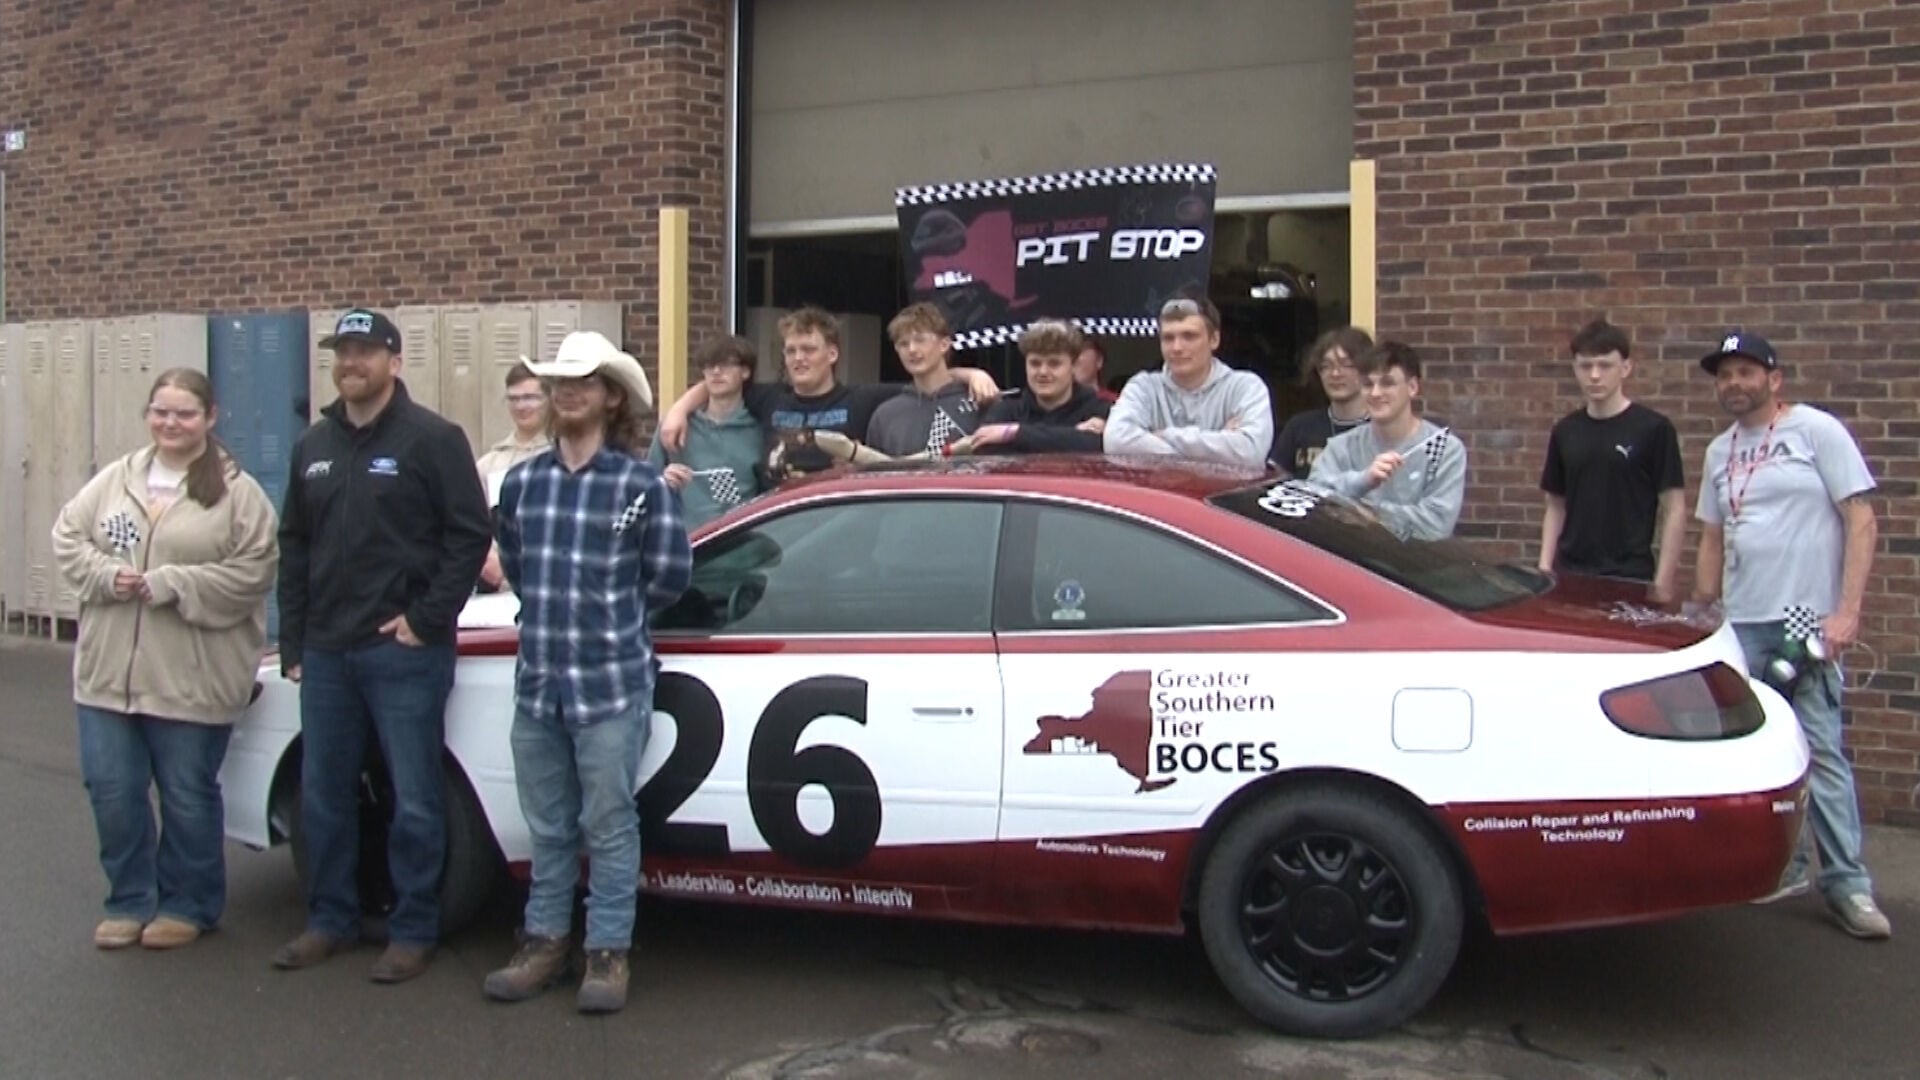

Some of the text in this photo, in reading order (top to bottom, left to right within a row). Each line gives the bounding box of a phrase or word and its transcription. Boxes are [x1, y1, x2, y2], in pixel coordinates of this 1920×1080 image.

[1016, 228, 1205, 268] PIT STOP
[1157, 668, 1251, 688] Greater
[1157, 690, 1275, 713] Southern
[1157, 717, 1205, 738] Tier
[634, 670, 882, 870] 26
[1156, 742, 1280, 773] BOCES
[1464, 806, 1696, 832] Collision Repair and Refinishing
[1541, 827, 1625, 843] Technology
[1036, 838, 1167, 862] Automotive Technology
[657, 868, 736, 895] Leadership
[746, 876, 842, 902] Collaboration
[852, 882, 913, 910] Integrity
